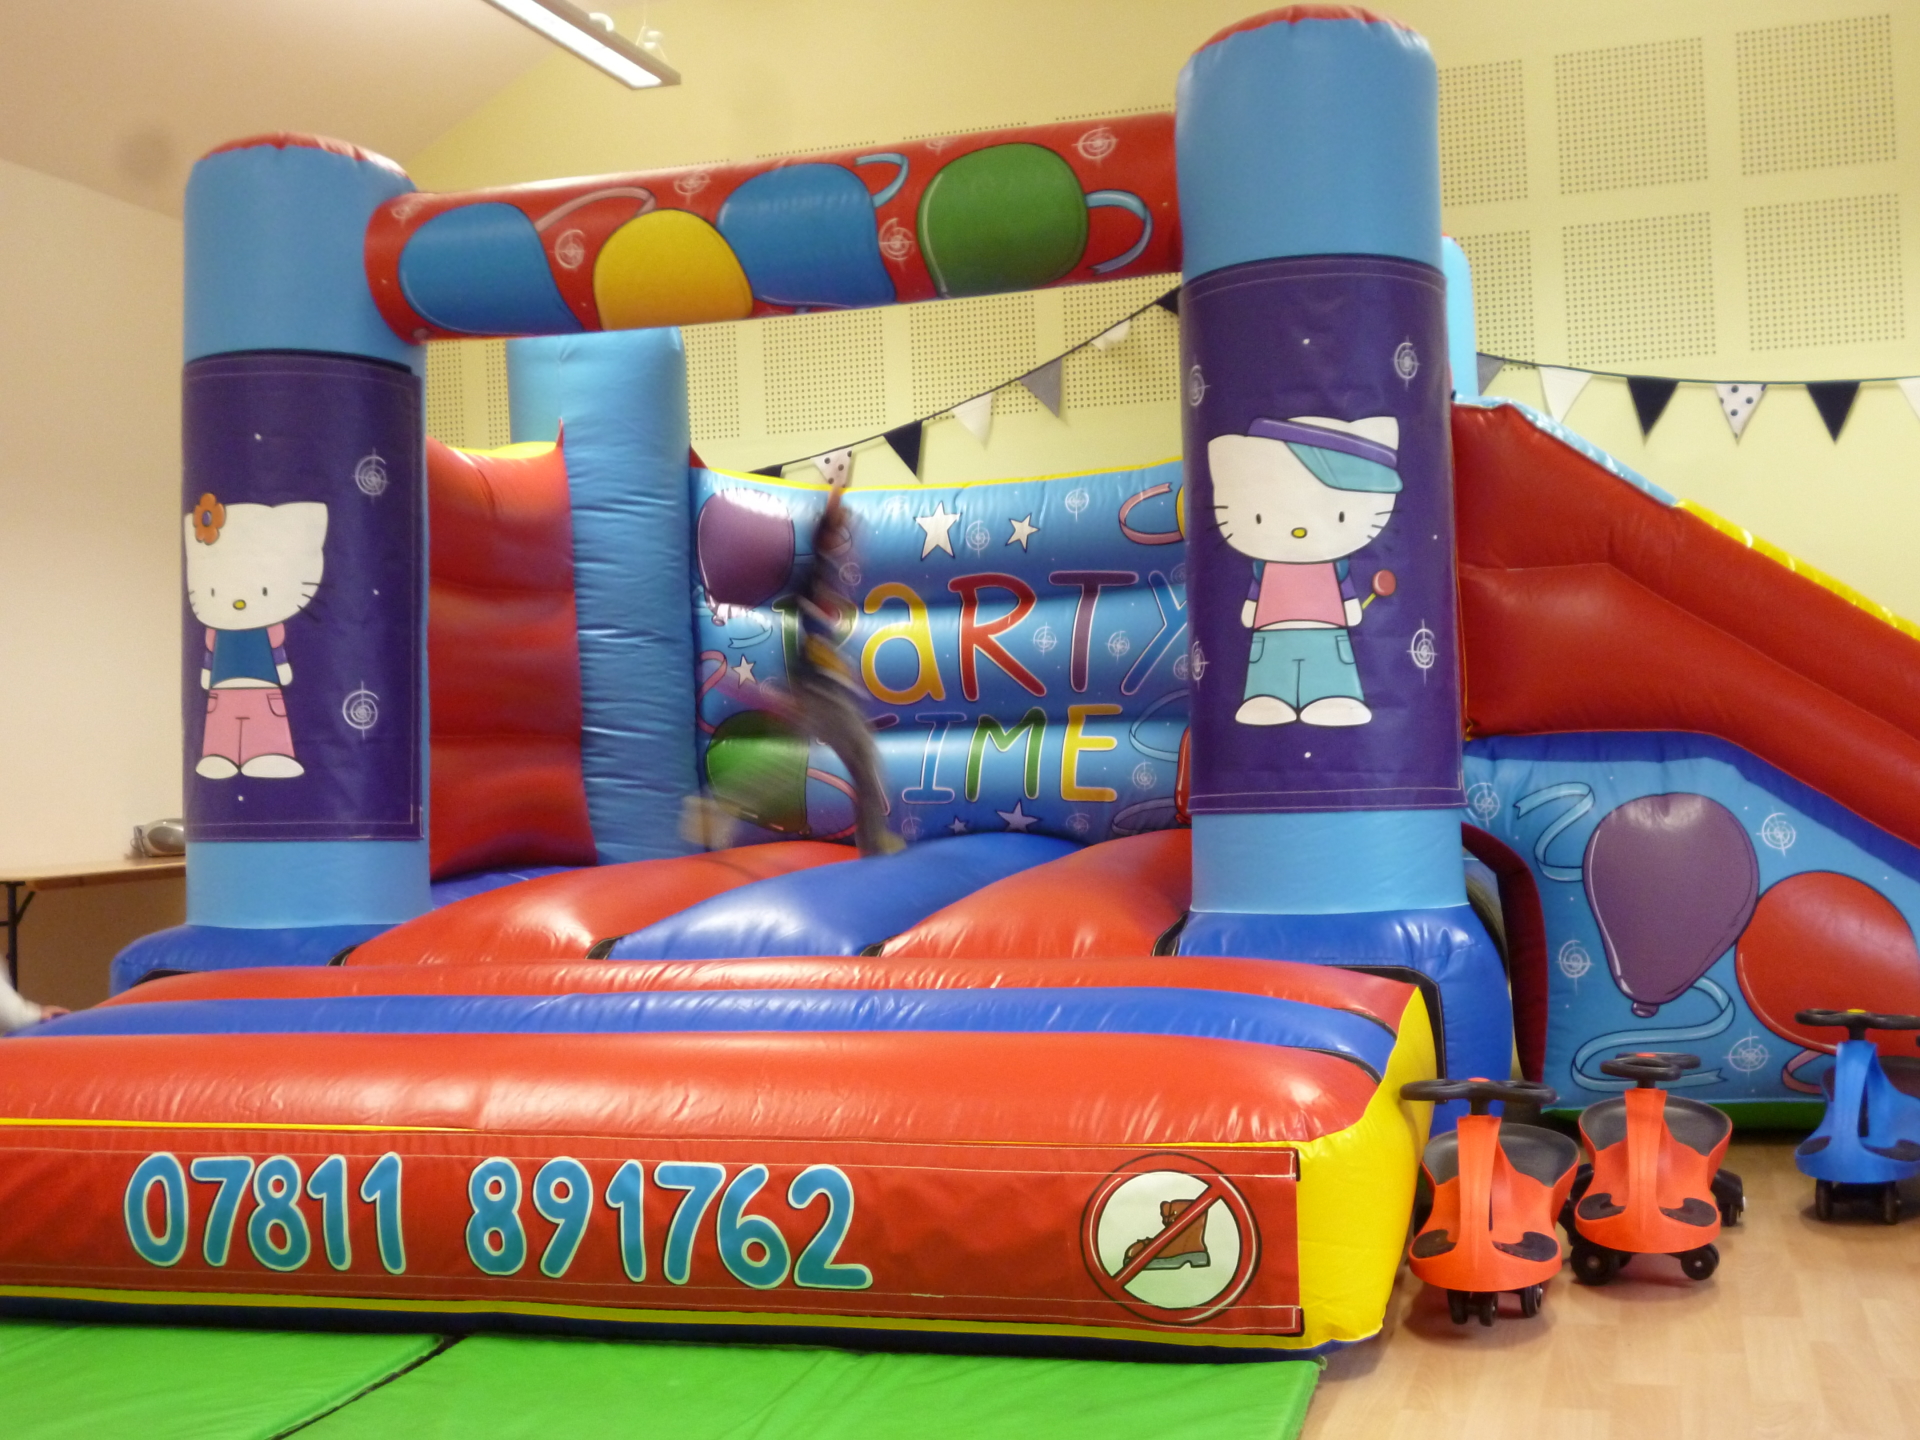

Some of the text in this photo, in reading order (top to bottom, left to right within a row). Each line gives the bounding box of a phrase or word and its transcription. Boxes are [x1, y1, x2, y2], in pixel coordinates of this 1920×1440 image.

[864, 704, 1123, 816] IME
[124, 1151, 873, 1290] 07811 891762
